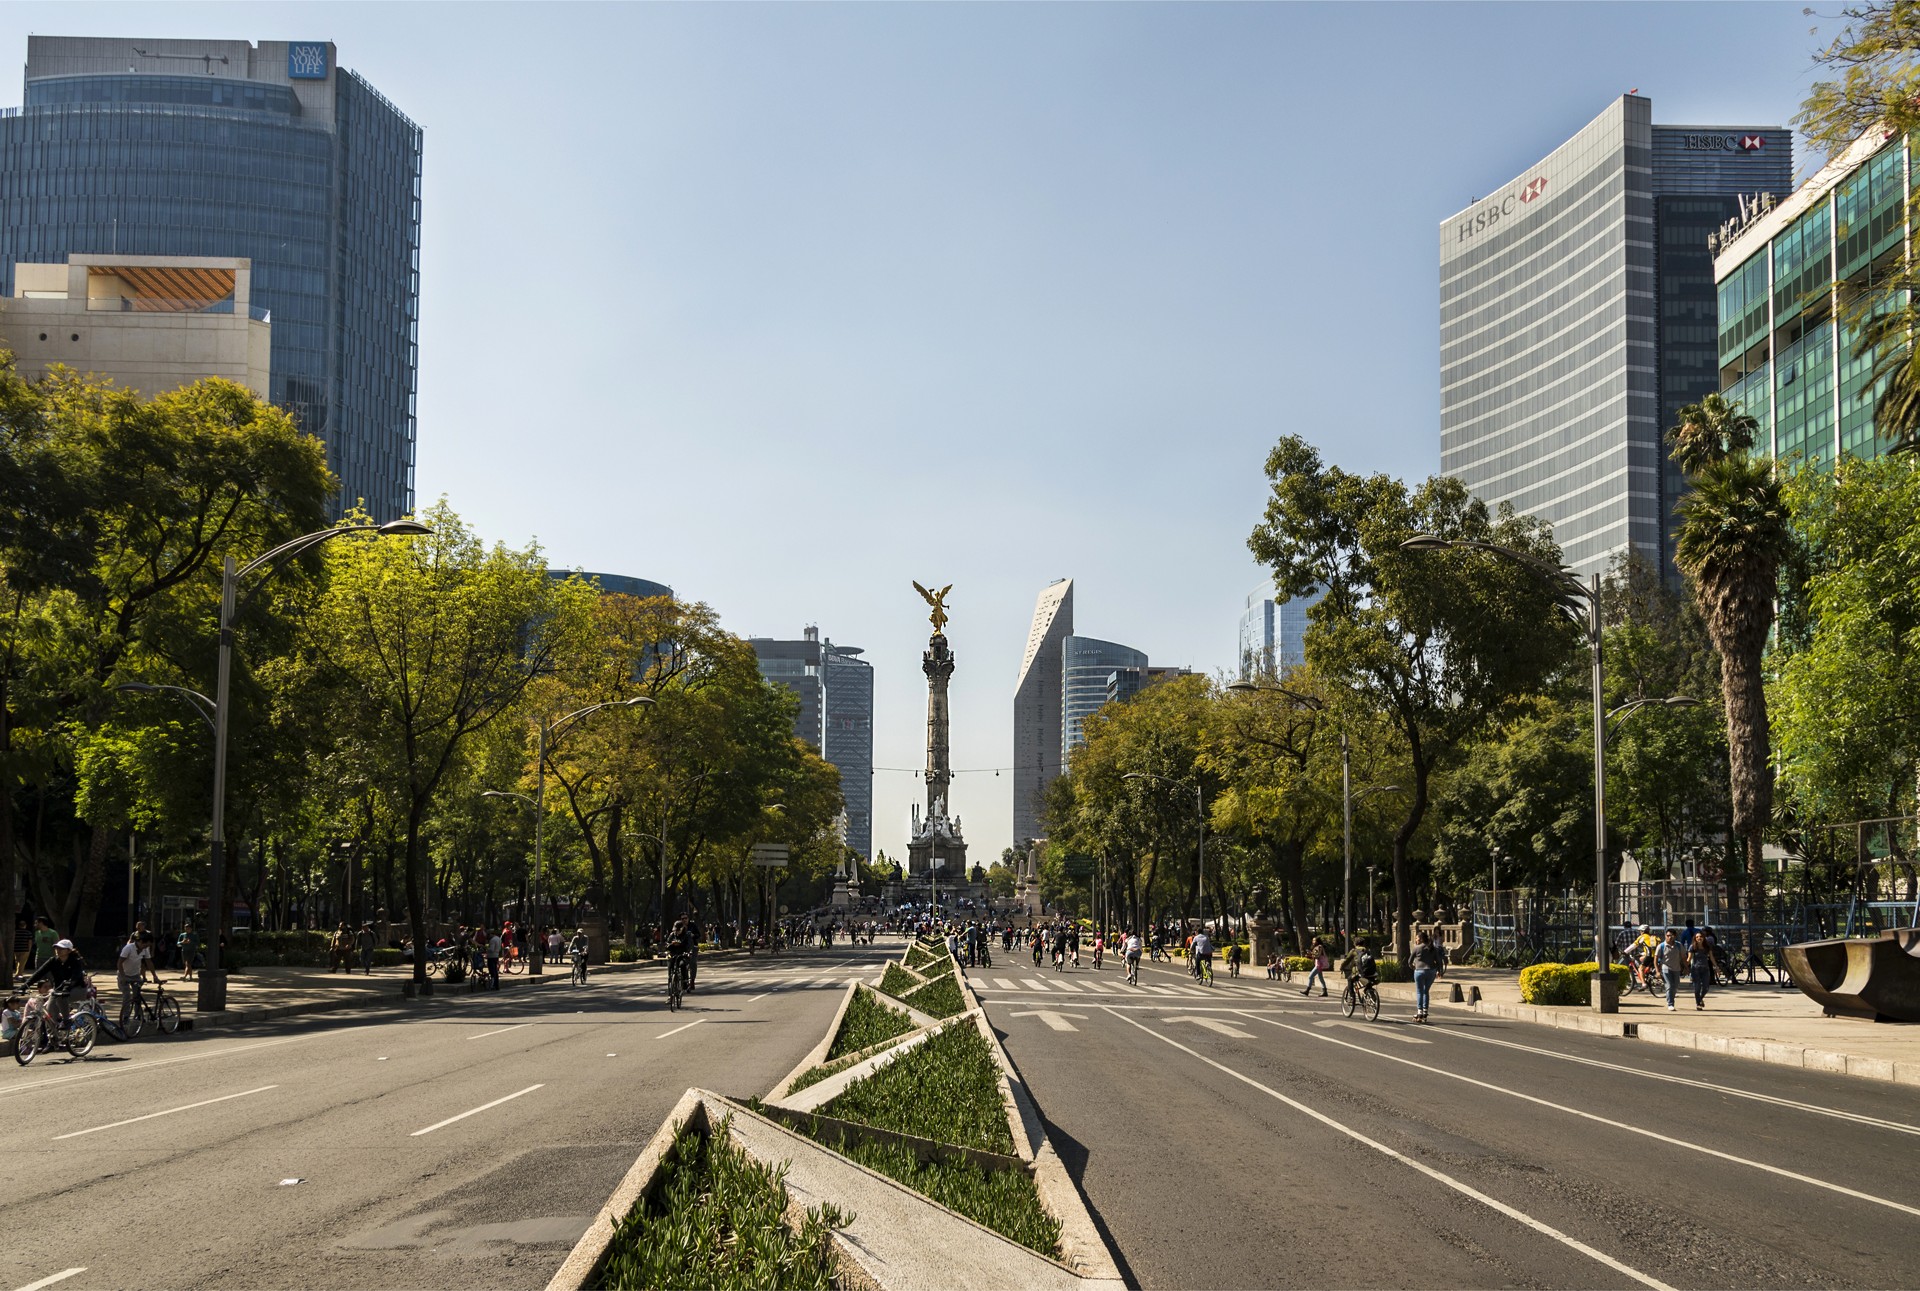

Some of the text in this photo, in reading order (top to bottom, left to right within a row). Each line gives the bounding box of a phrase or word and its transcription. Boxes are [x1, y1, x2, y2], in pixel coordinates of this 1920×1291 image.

[295, 46, 321, 56] NEW
[290, 54, 324, 65] YORK
[295, 63, 320, 74] LIFE
[1683, 134, 1738, 151] HSBC
[1458, 193, 1516, 243] HSBC
